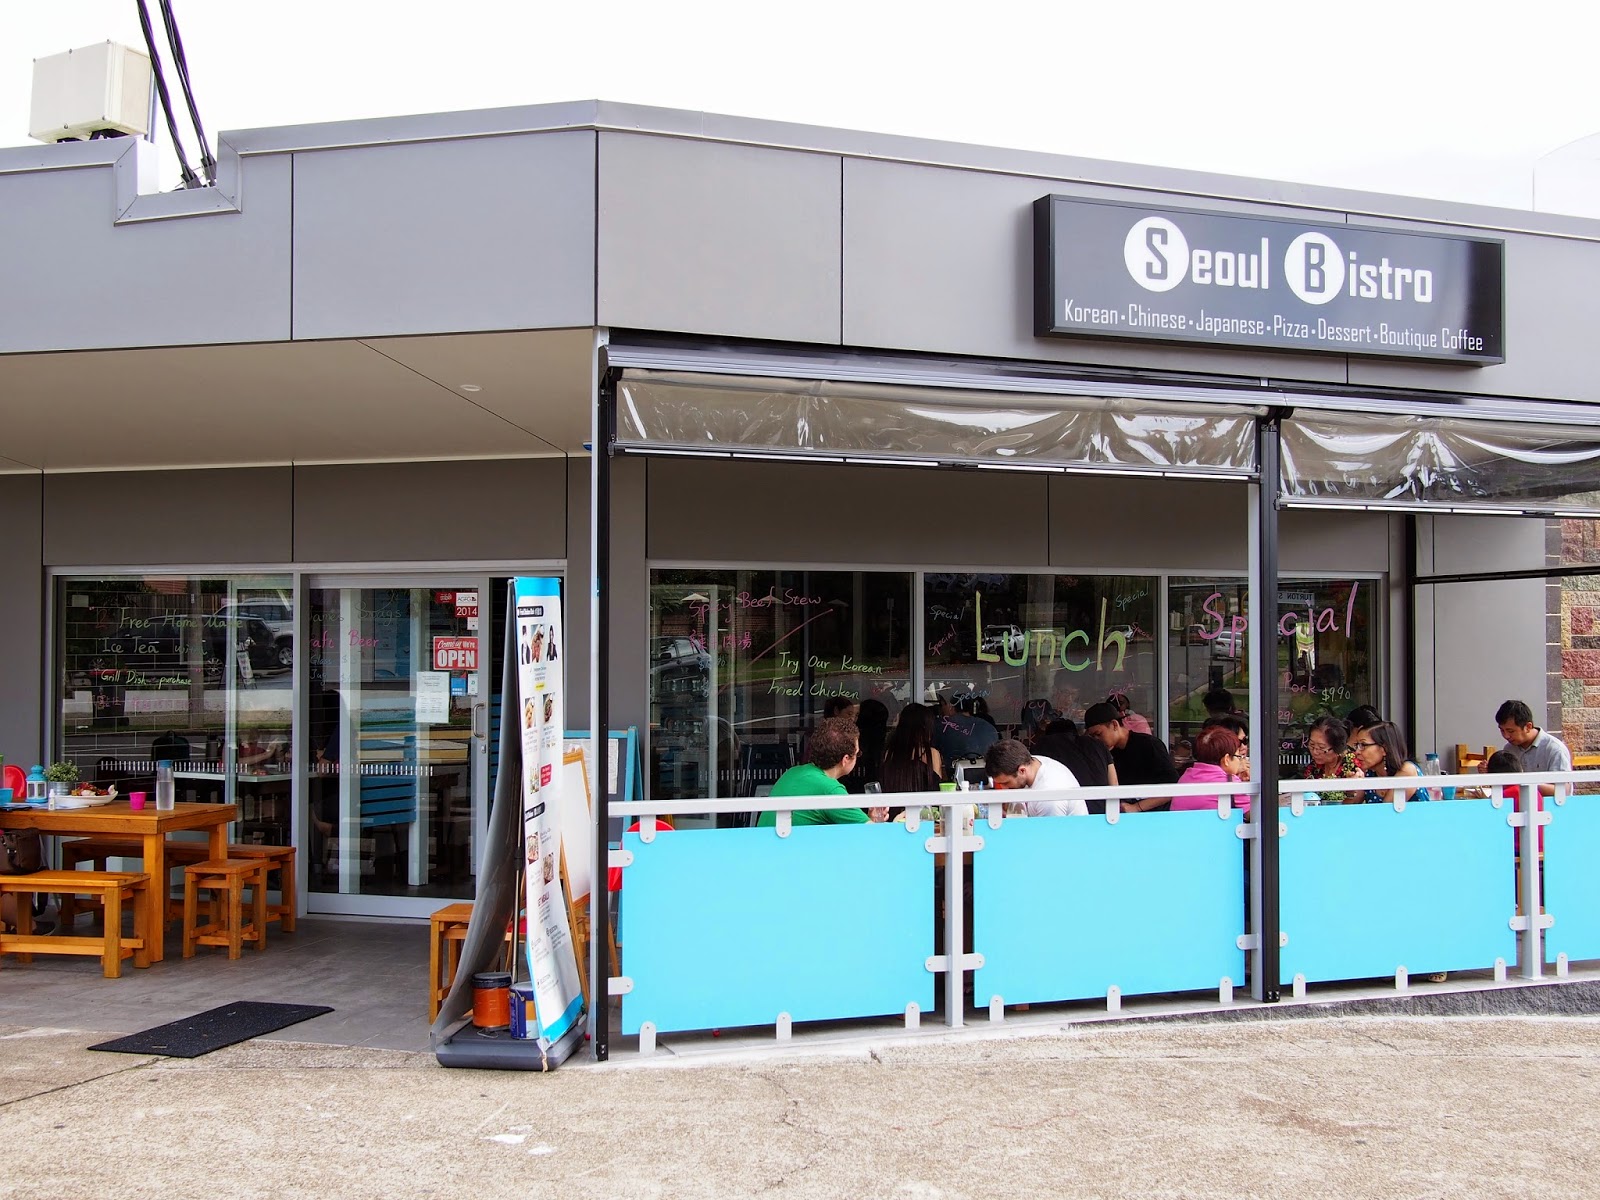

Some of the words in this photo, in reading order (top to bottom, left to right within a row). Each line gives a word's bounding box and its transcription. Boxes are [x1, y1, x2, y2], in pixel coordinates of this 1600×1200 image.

[1124, 216, 1269, 292] Seoul
[1284, 232, 1433, 305] Bistro
[1064, 299, 1118, 325] Korean
[1128, 304, 1186, 330] Chinese
[1195, 310, 1264, 337] Japanese
[1273, 314, 1309, 338] Pizza
[1318, 318, 1372, 344] Dessert
[1379, 323, 1437, 351] Boutique
[1441, 327, 1484, 352] Coffee
[119, 607, 151, 629] Free
[456, 606, 477, 616] 2014
[1198, 581, 1359, 657] Spcial
[976, 590, 1127, 672] Lunch
[132, 636, 159, 654] Tea
[437, 649, 475, 667] OPEN
[779, 651, 799, 674] Try
[808, 655, 830, 669] Our
[841, 655, 883, 675] Korean
[101, 669, 120, 683] Grill
[1283, 671, 1317, 694] Pork
[767, 678, 804, 698] Fried
[810, 680, 860, 700] Chicken
[951, 689, 991, 710] Specia
